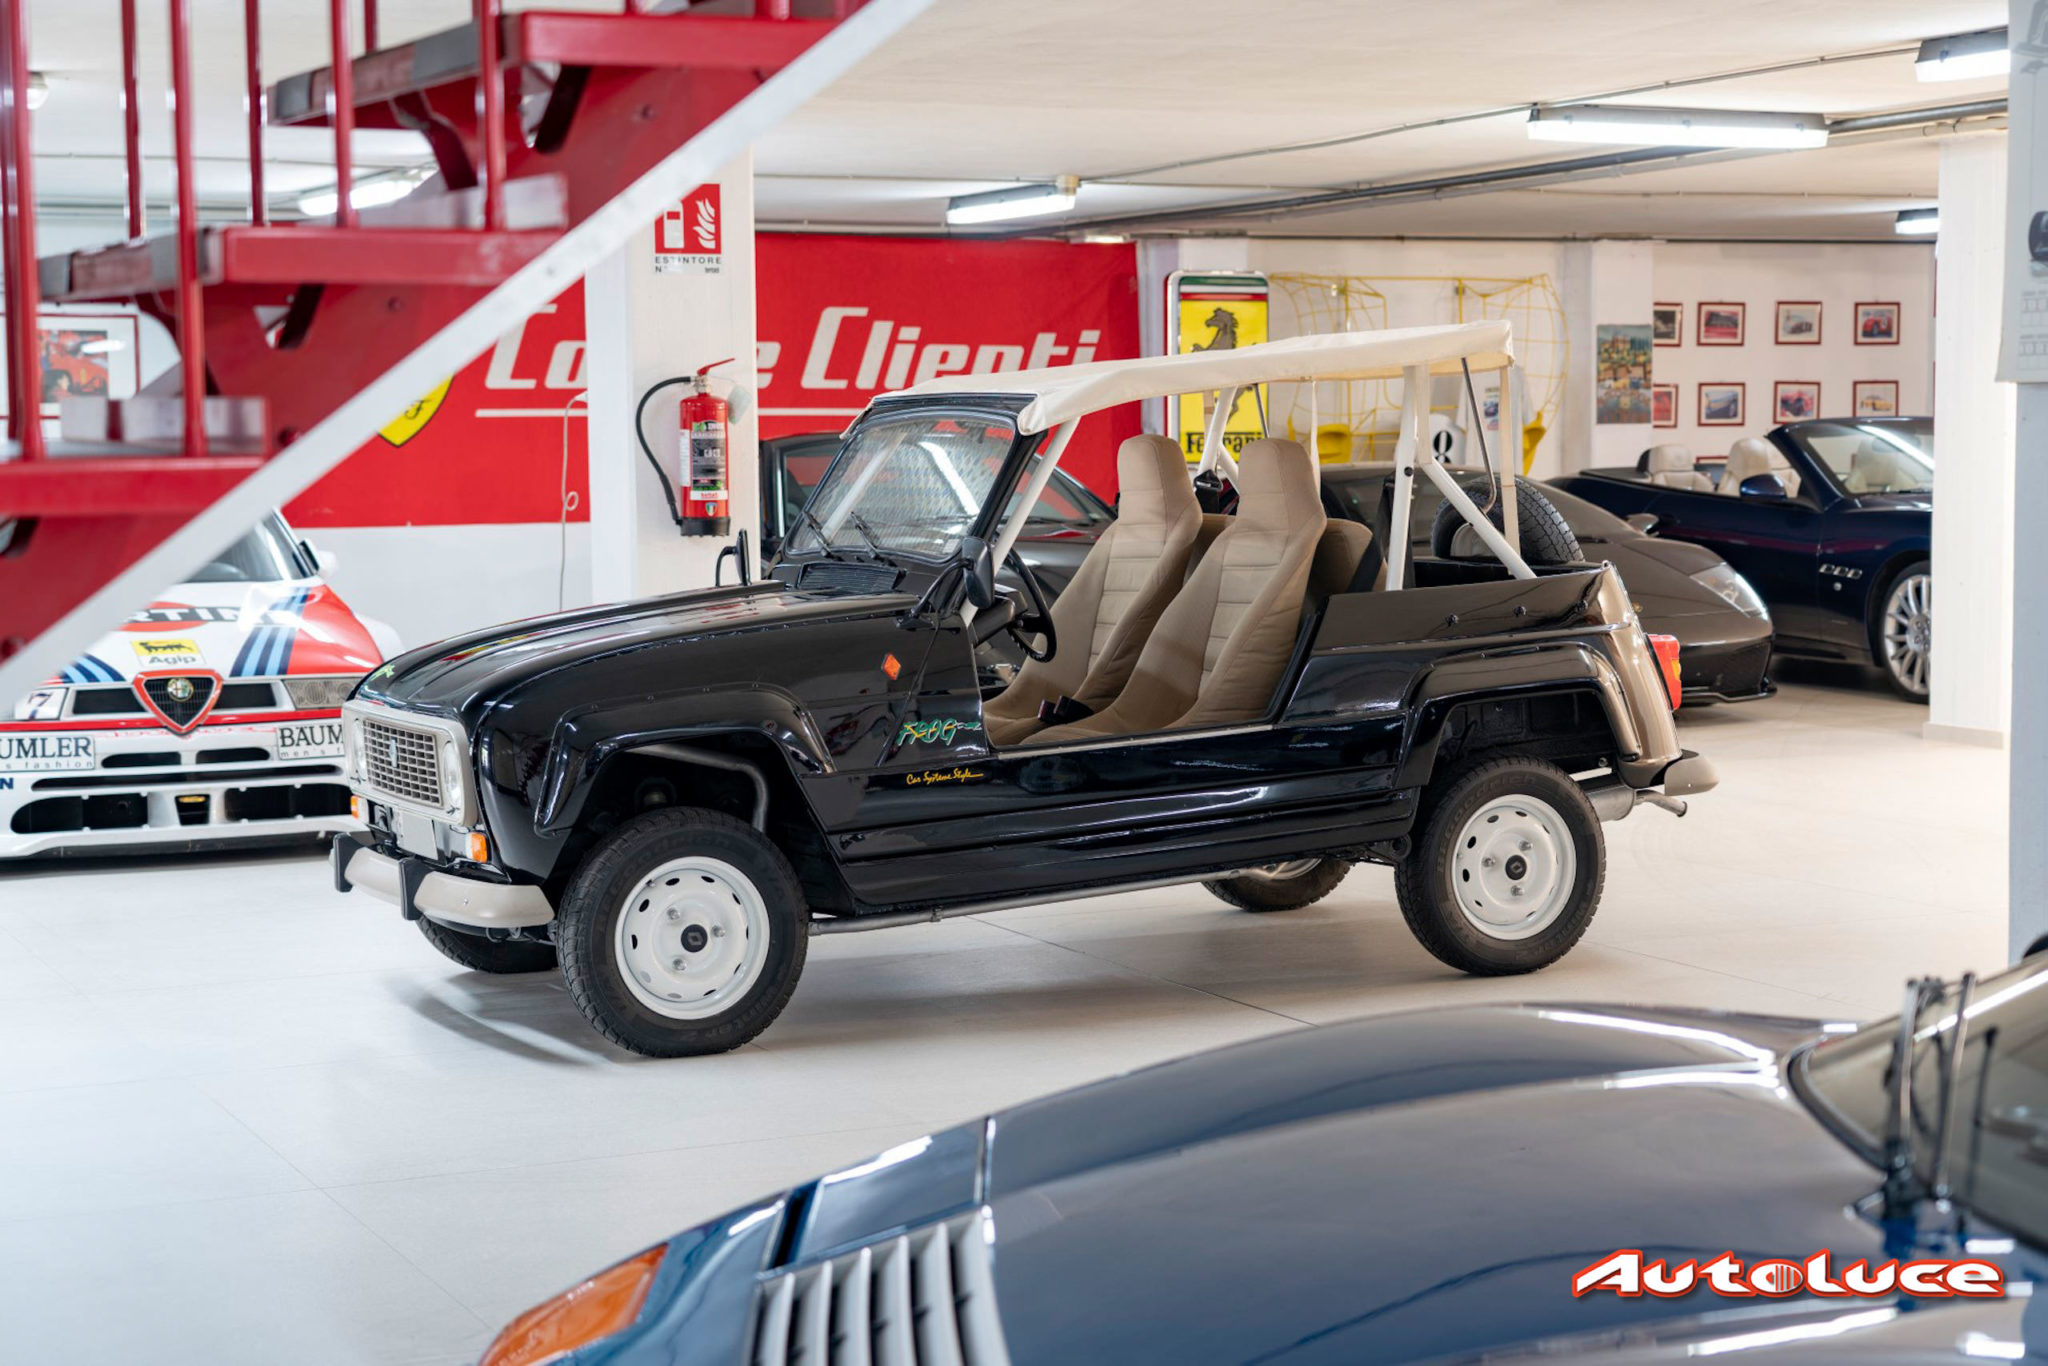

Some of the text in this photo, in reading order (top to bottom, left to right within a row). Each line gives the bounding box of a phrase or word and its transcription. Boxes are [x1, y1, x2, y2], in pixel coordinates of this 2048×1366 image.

[655, 256, 722, 264] ESTINTORE
[801, 306, 1101, 389] Clienti
[149, 655, 196, 665] Agip
[0, 737, 92, 759] UMLER
[25, 760, 93, 769] fashion
